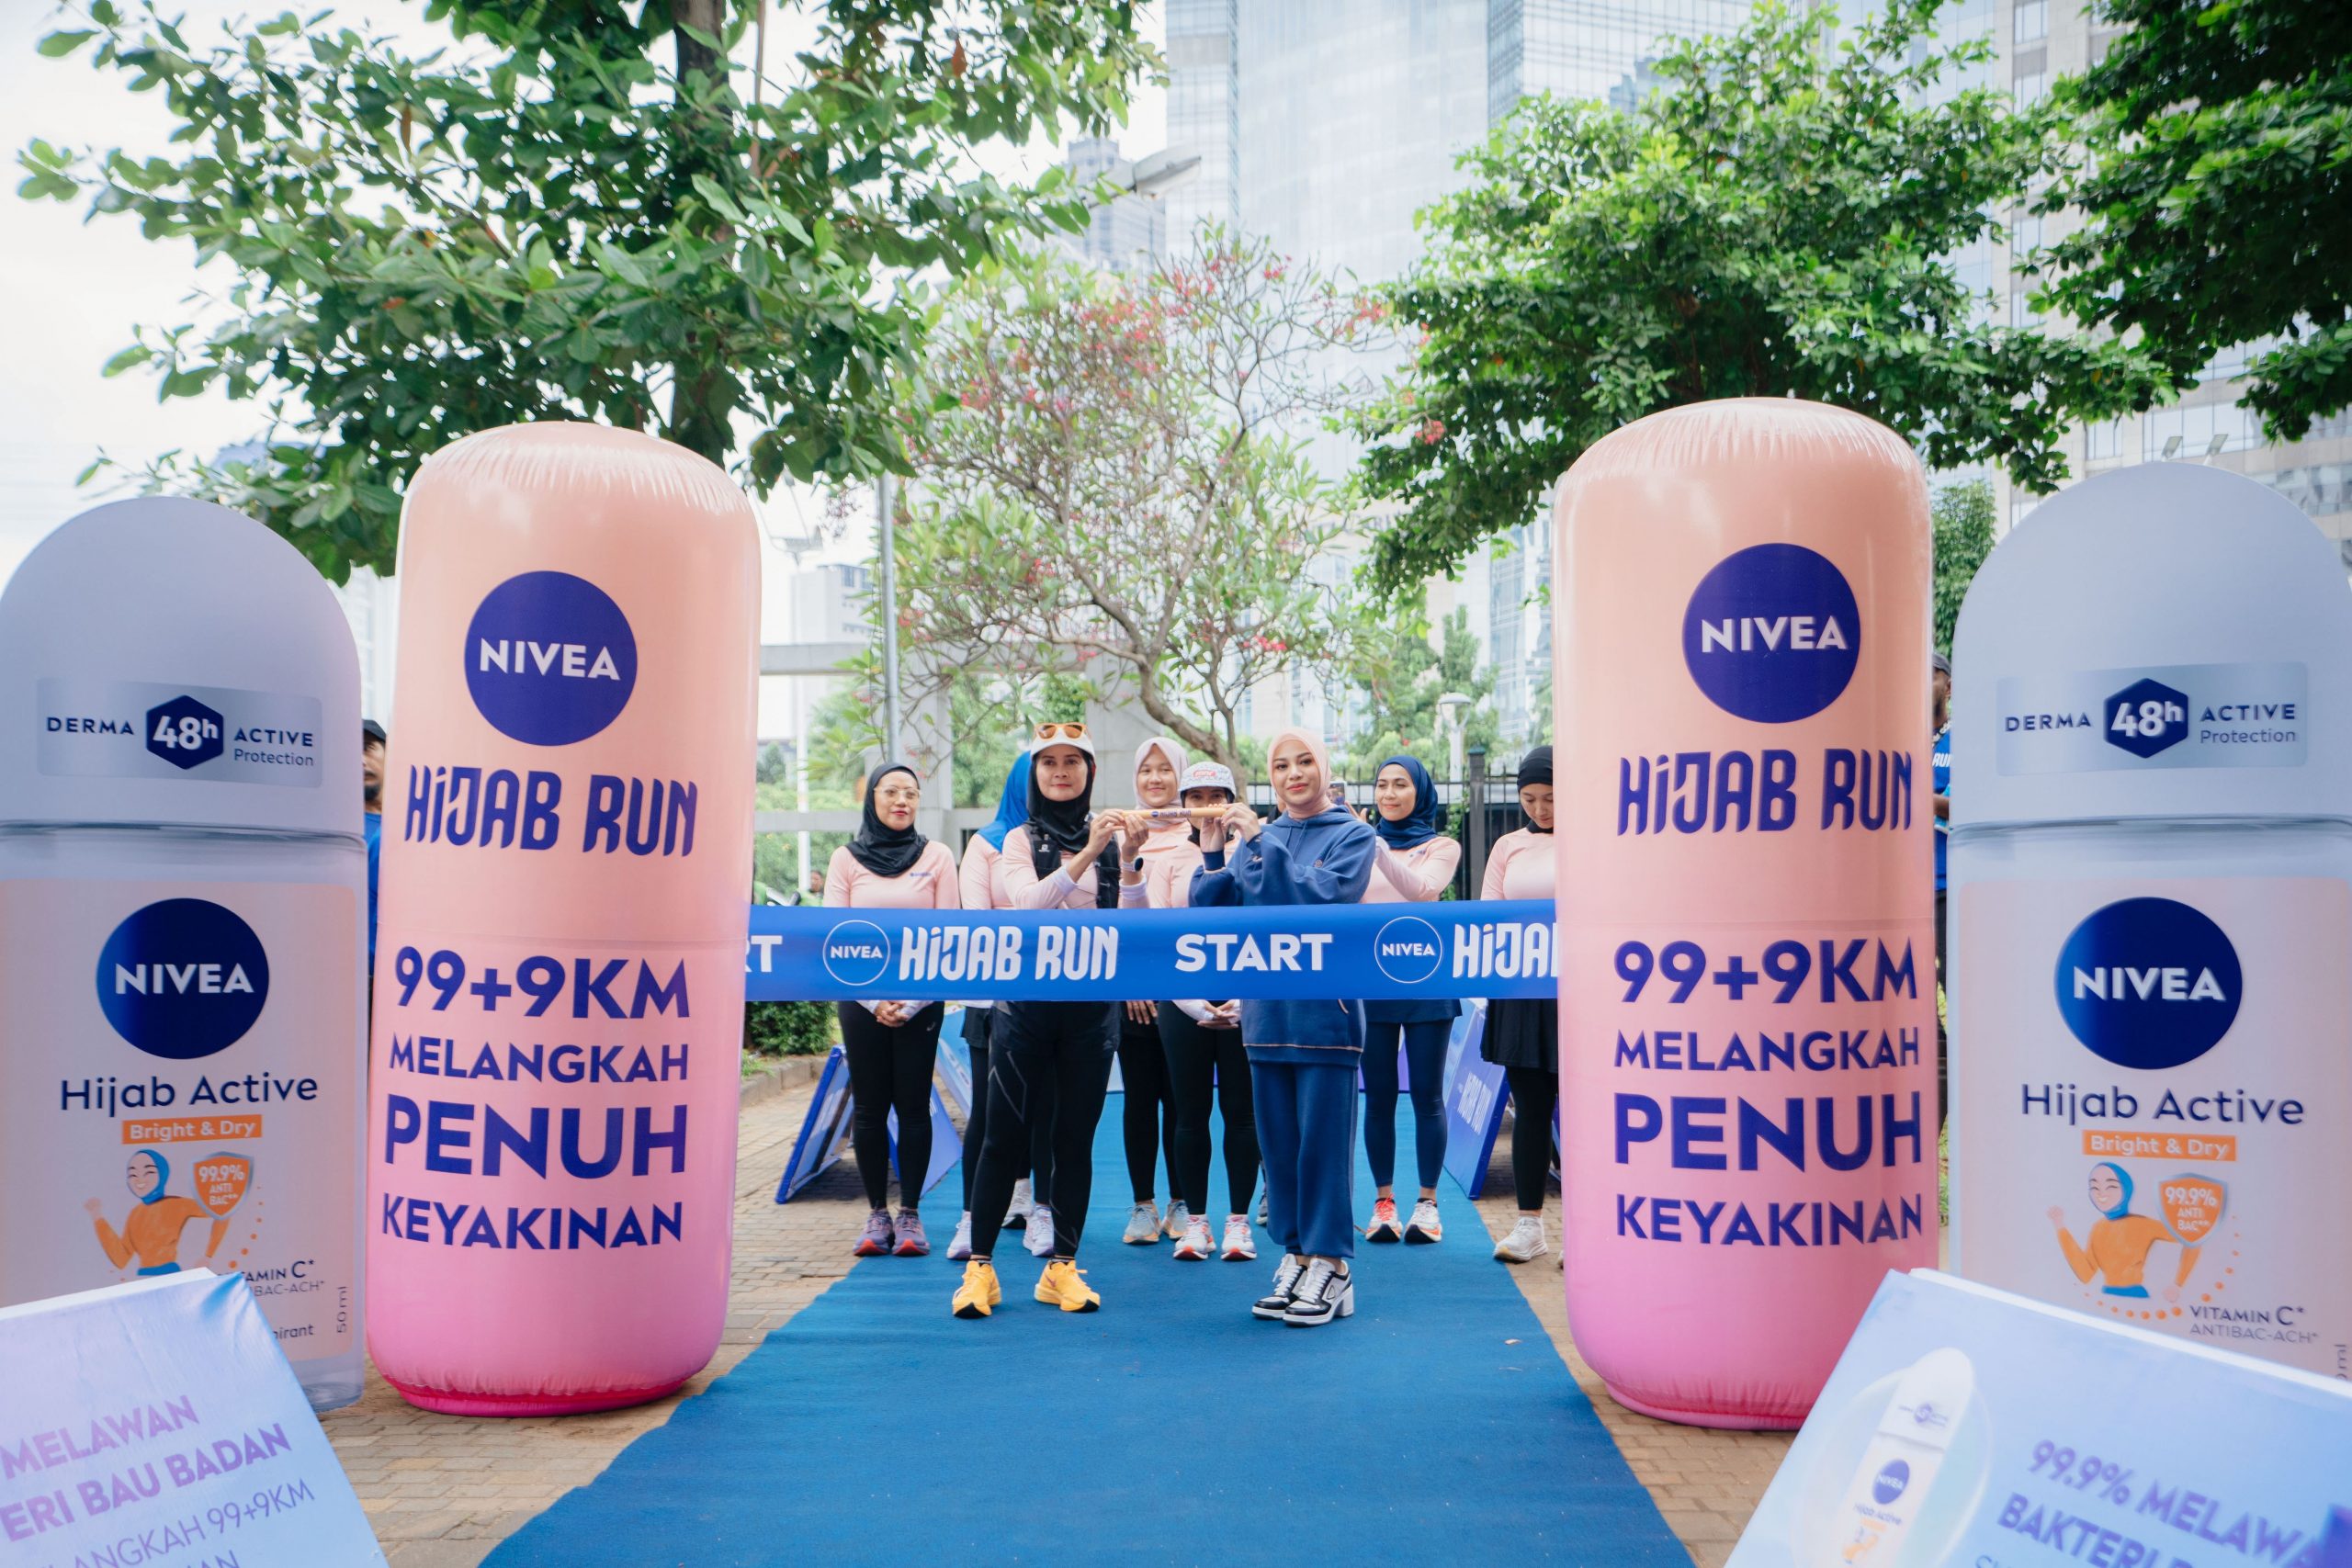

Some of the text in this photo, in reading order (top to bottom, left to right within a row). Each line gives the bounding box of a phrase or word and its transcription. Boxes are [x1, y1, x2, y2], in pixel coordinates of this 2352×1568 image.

[1702, 615, 1847, 653] NIVEA
[480, 637, 620, 680] NIVEA
[47, 716, 313, 750] DERMA 48h ACTIVE
[2006, 701, 2296, 737] DERMA 48h ACTIVE
[2200, 728, 2297, 744] Protection
[234, 748, 313, 766] Protection
[1821, 748, 1912, 831] RUN
[582, 774, 697, 857] RUN
[745, 935, 783, 972] T
[830, 945, 883, 959] NIVEA
[1035, 925, 1118, 980] RUN
[1174, 933, 1332, 972] START
[1382, 942, 1435, 956] NIVEA
[1453, 922, 1558, 978] HiJA
[1614, 937, 1917, 1004] 99+9KM
[115, 963, 254, 995] NIVEA
[395, 946, 689, 1019] 99+9KM
[2074, 966, 2225, 1001] NIVEA
[390, 1032, 688, 1083] MELANGKAH
[1614, 1027, 1918, 1072] MELANGKAH
[61, 1071, 318, 1117] Hijab Active
[2021, 1083, 2304, 1125] Hijab Active
[130, 1117, 256, 1141] Bright & Dry
[384, 1093, 687, 1179] PENUH
[1614, 1091, 1921, 1173] PENUH
[2090, 1135, 2228, 1159] Bright & Dry
[198, 1164, 245, 1182] 99.9%
[2165, 1187, 2218, 1207] 99.9%
[382, 1192, 683, 1250] KEYAKINAN
[1617, 1193, 1922, 1247] KEYAKINAN
[243, 1269, 287, 1281] AMIN
[254, 1280, 324, 1297] BAC-ACH
[337, 1286, 348, 1333] 50 ml
[2189, 1305, 2270, 1324] VITAMIN
[1, 1394, 200, 1480] MELAWAN
[76, 1462, 161, 1517] BAU
[164, 1423, 292, 1488] BADAN
[2027, 1438, 2134, 1506] 99.9%
[207, 1478, 316, 1535] 99+9KM
[1996, 1492, 2164, 1568] BAKTERI
